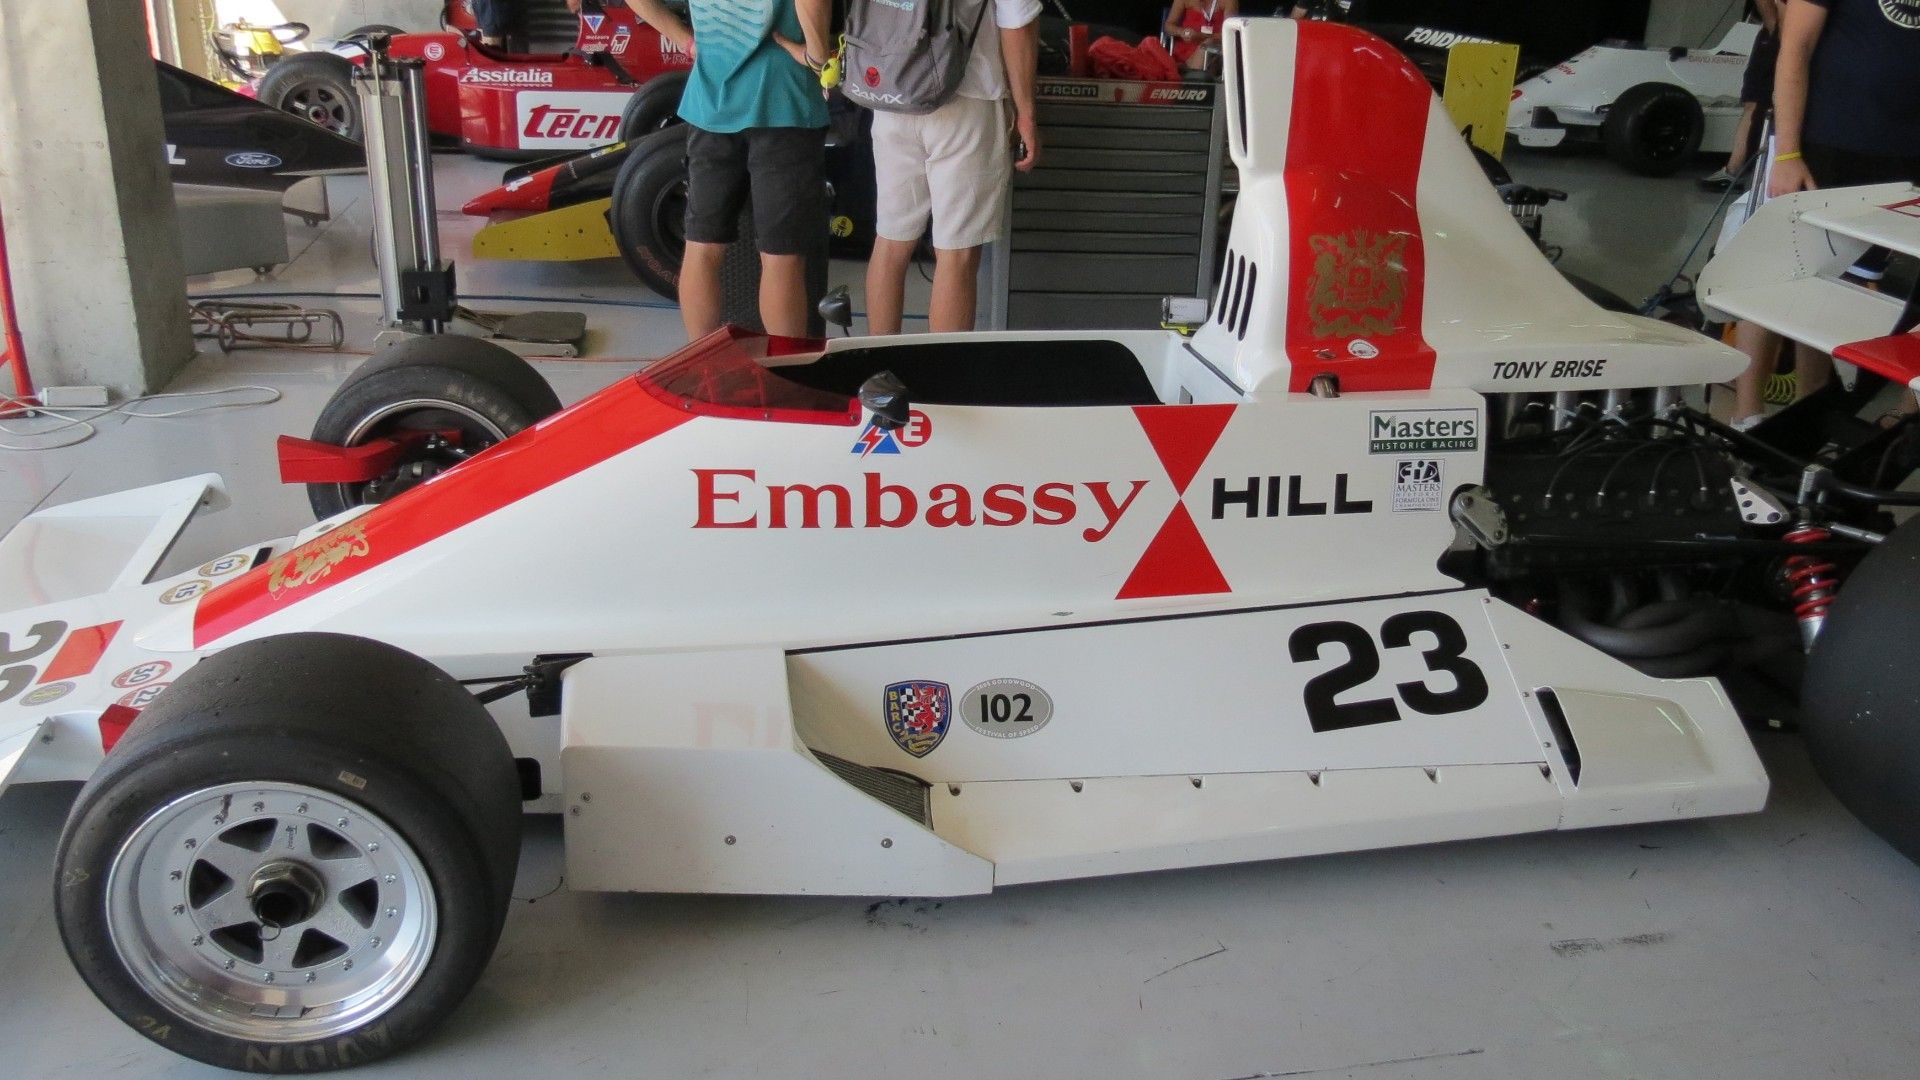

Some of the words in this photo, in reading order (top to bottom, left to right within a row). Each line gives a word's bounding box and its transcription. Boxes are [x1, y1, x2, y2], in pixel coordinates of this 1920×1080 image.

[460, 67, 553, 84] Assitalia
[1150, 88, 1208, 101] ENDURO
[523, 104, 622, 140] tecn
[1492, 361, 1548, 380] TONY
[1550, 359, 1607, 379] BRISE
[1373, 415, 1475, 439] Masters
[1373, 441, 1426, 451] HISTORIC
[1432, 440, 1475, 449] RACING
[1395, 483, 1441, 493] MASTERS
[689, 467, 1150, 544] Embassy
[1211, 473, 1374, 520] HILL
[214, 558, 235, 573] 12
[175, 584, 198, 599] 15
[129, 665, 157, 684] 30
[1287, 609, 1490, 734] 23
[887, 690, 904, 734] BARC
[980, 693, 1034, 723] 102
[974, 726, 1007, 739] FESTIVAL
[1018, 724, 1040, 737] SPEED
